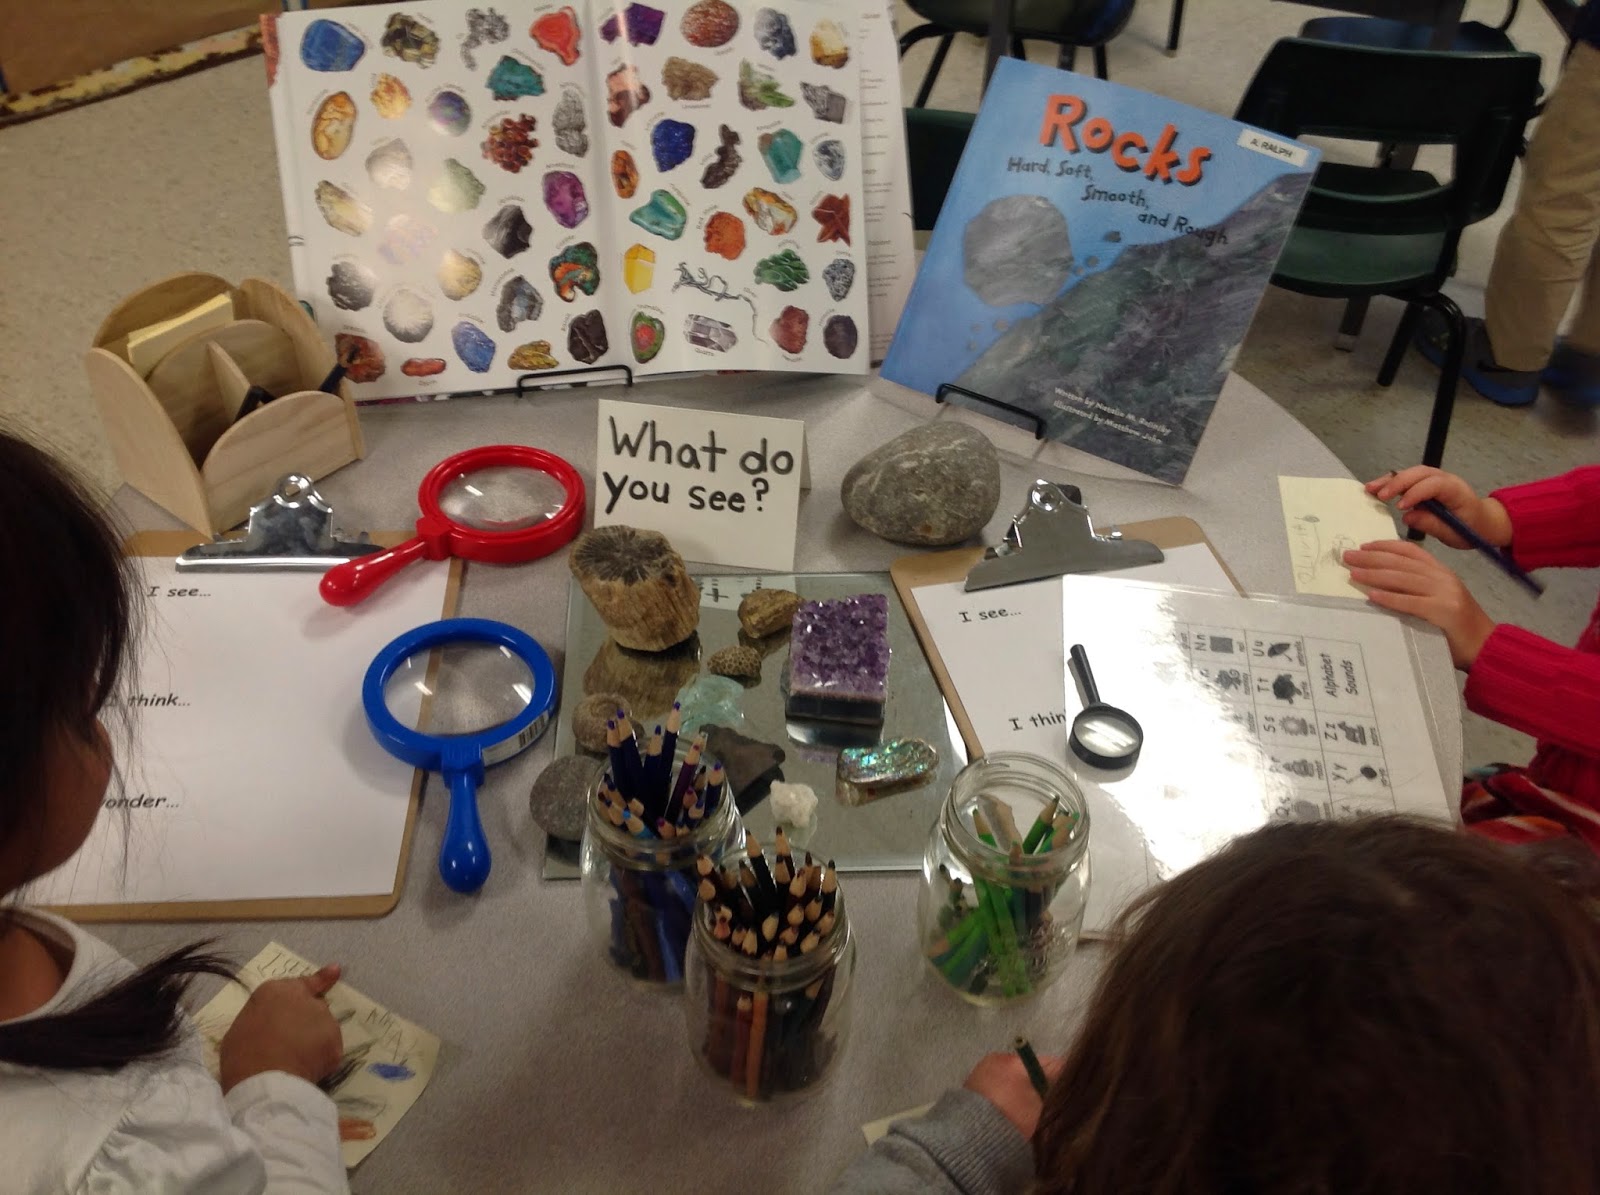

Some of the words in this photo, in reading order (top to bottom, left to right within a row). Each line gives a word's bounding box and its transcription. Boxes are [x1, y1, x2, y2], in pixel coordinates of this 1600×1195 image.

[1039, 94, 1212, 187] Rocks
[1261, 142, 1293, 157] RALPH
[1008, 157, 1050, 176] Hard,
[1055, 160, 1093, 181] Soft,
[1081, 184, 1149, 210] Smooth,
[1137, 211, 1168, 228] and
[1174, 216, 1228, 247] Rough
[1084, 397, 1096, 408] by
[1093, 413, 1105, 425] by
[608, 415, 727, 473] What
[739, 437, 794, 475] do
[602, 471, 670, 515] you
[688, 477, 770, 513] see?
[146, 586, 160, 597] I
[959, 611, 972, 623] I
[979, 608, 1021, 621] see...
[1320, 652, 1338, 698] Alphabet
[1340, 659, 1359, 696] Sounds
[1008, 718, 1023, 731] I
[1029, 712, 1066, 728] thin
[101, 794, 179, 809] onder...
